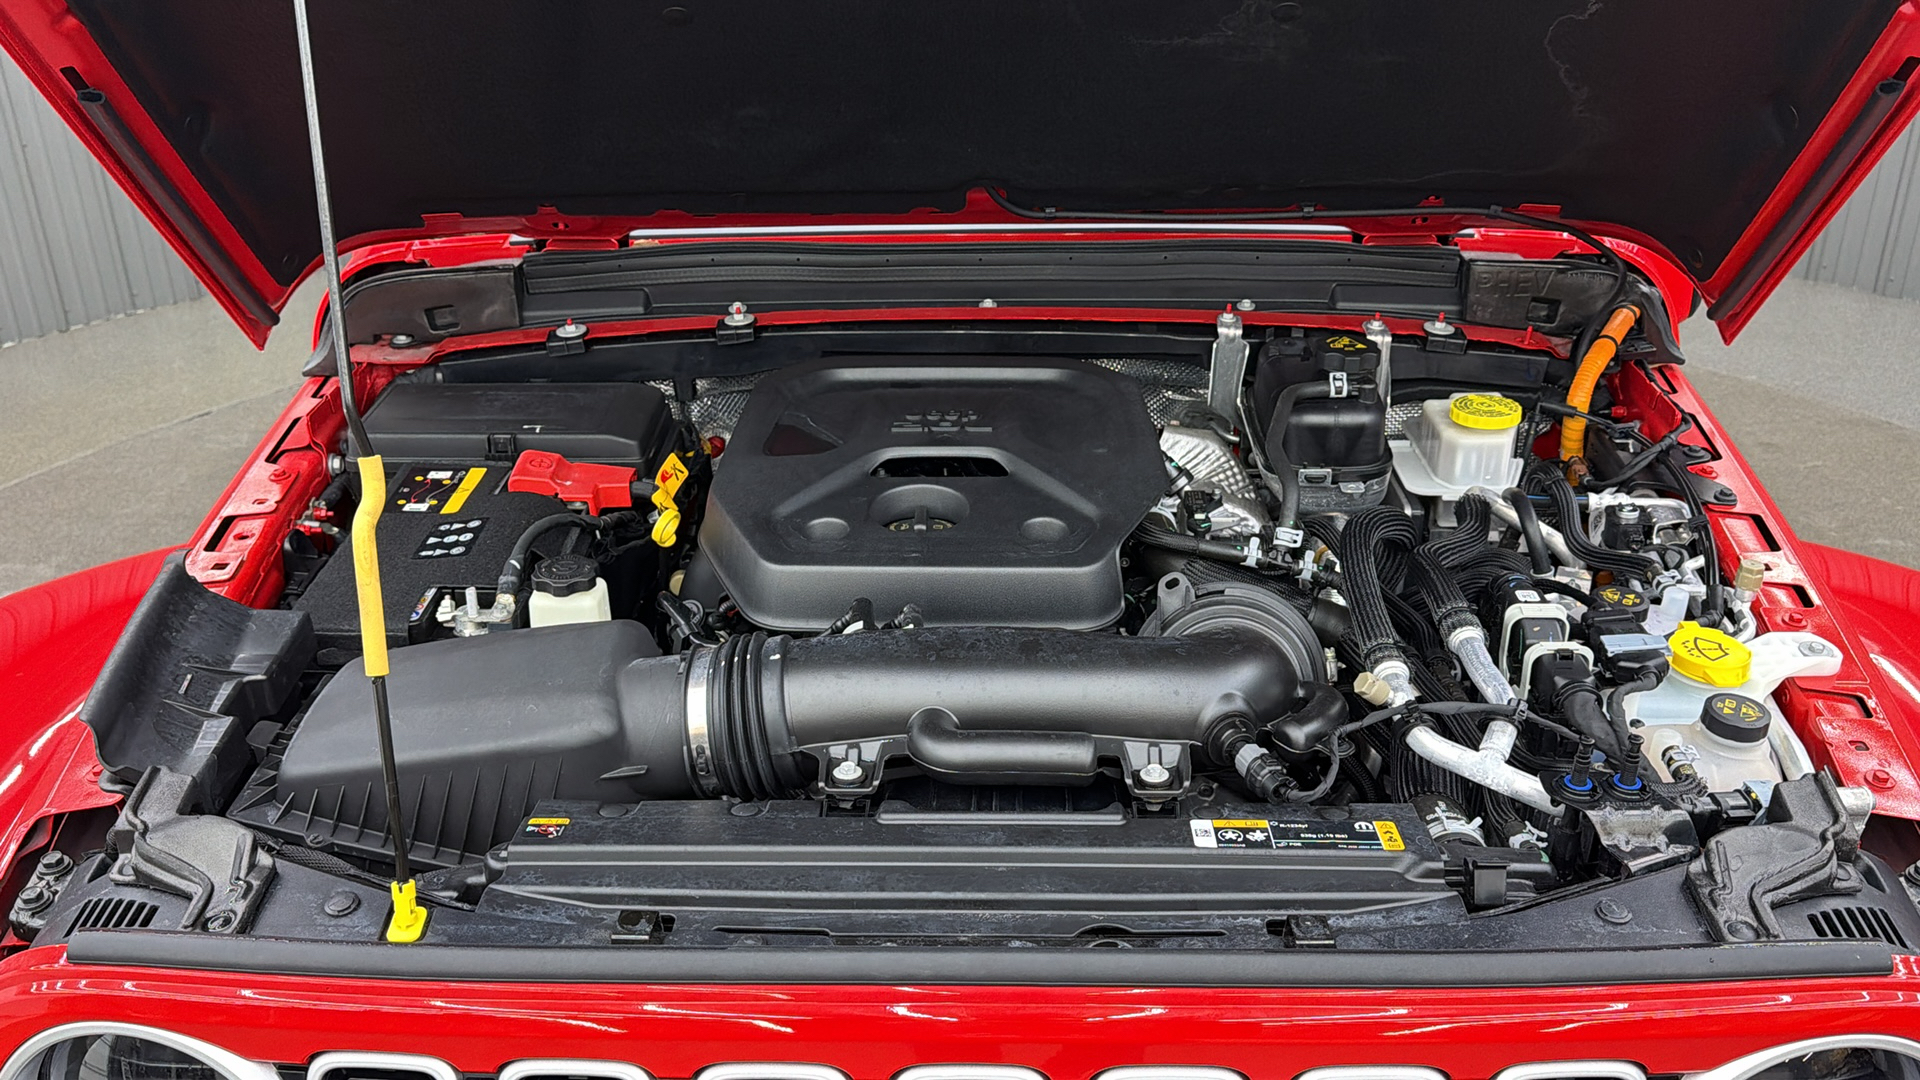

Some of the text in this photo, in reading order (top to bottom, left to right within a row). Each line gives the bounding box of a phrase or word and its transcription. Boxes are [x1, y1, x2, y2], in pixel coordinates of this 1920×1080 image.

[1475, 270, 1555, 297] PHEV
[904, 407, 982, 422] Jeep
[891, 420, 993, 433] 2.0L
